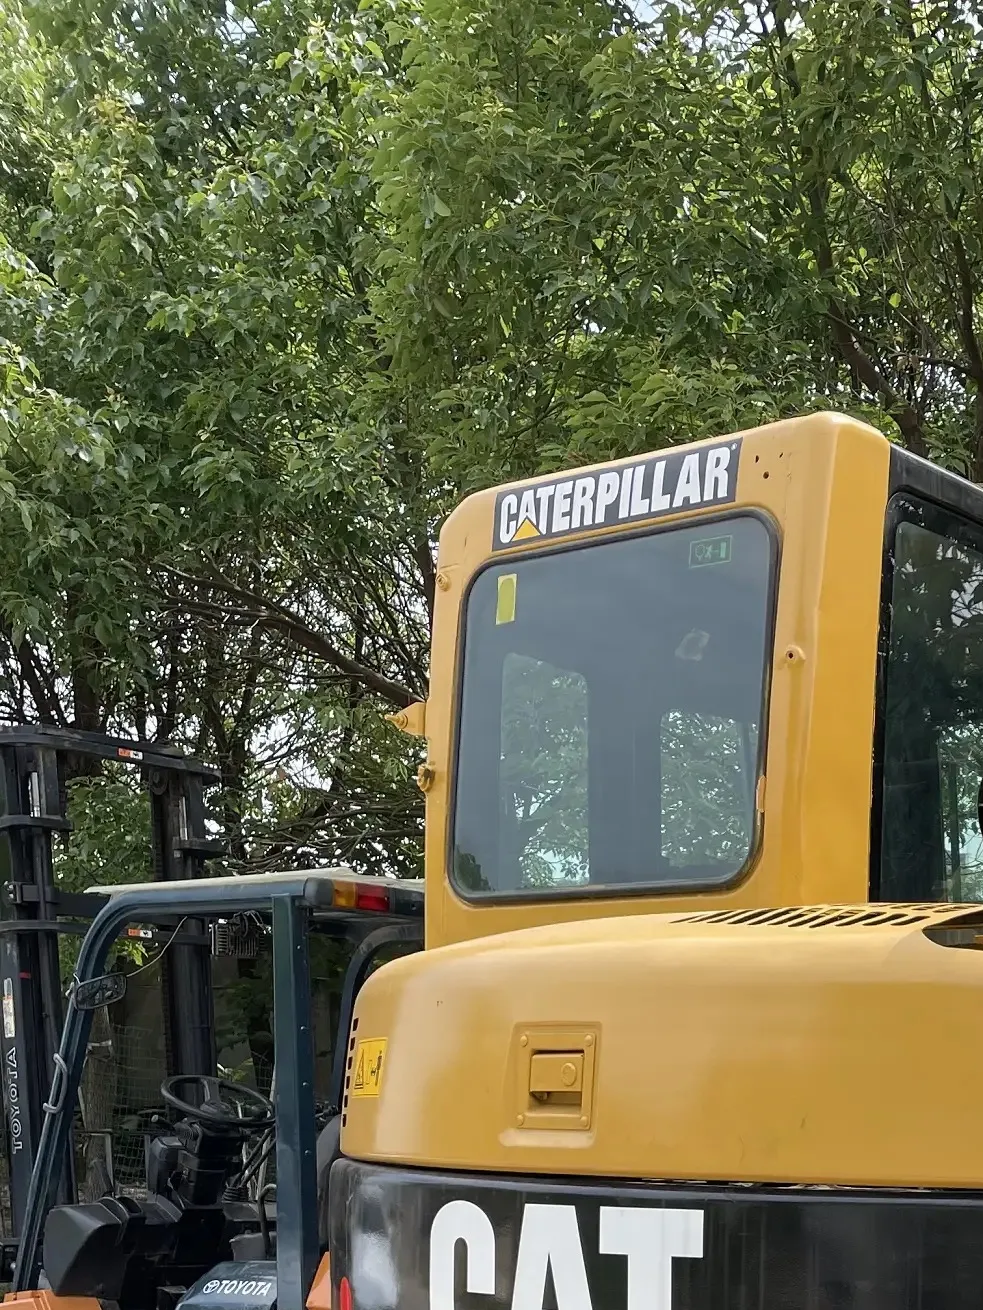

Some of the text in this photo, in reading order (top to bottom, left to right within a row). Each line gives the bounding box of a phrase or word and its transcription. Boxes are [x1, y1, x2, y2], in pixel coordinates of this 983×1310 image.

[499, 446, 731, 544] CATERPILLAR
[6, 1047, 22, 1155] TOYOTA
[217, 1280, 272, 1296] TOYOTA
